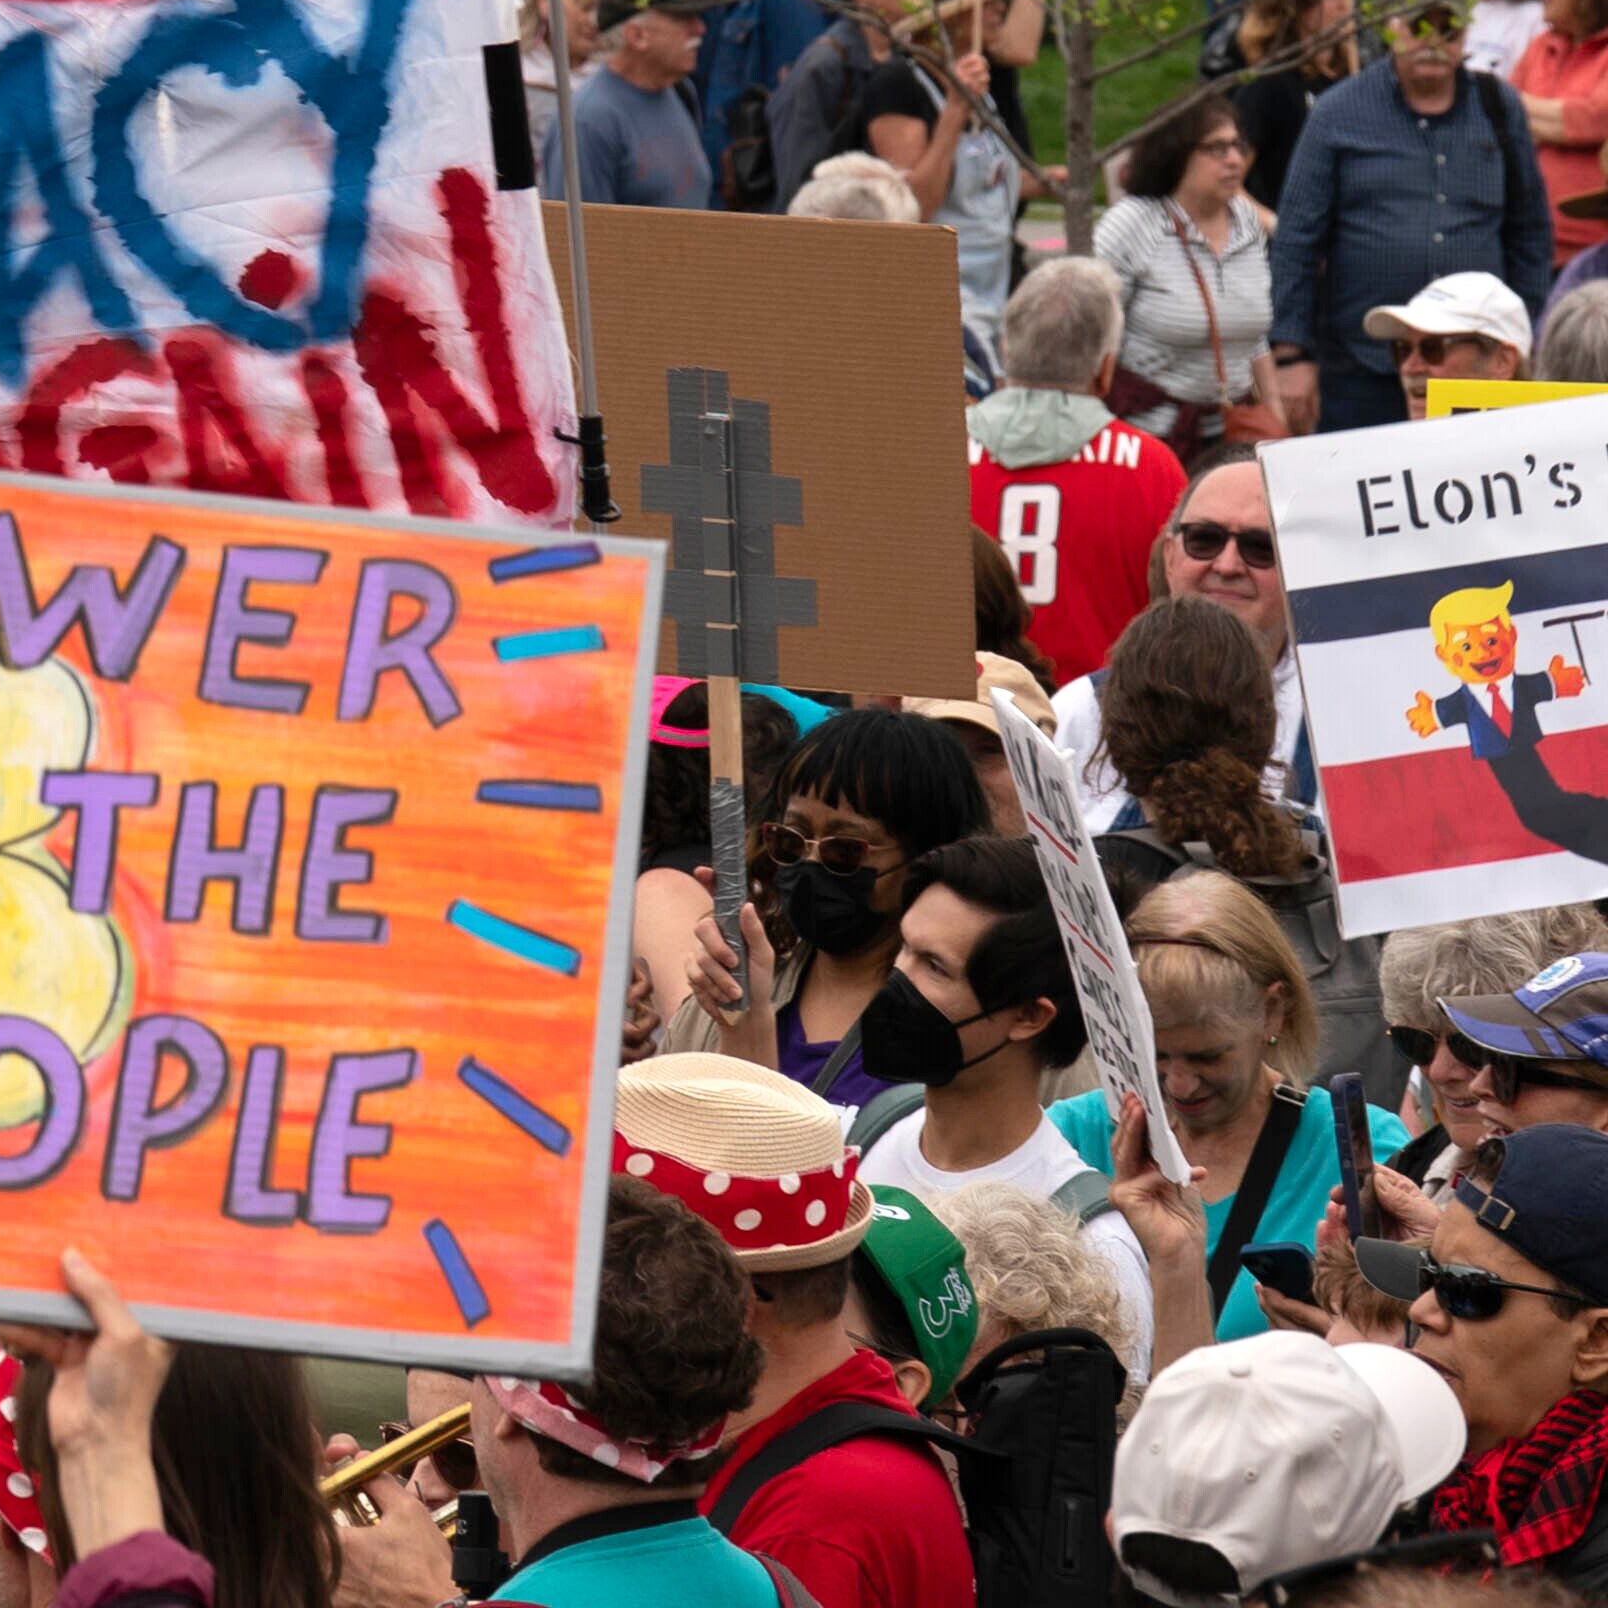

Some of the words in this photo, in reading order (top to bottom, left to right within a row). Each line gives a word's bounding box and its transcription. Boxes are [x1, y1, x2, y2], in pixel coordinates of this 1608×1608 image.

[998, 482, 1062, 606] 8
[1357, 453, 1585, 540] Elon's
[41, 768, 399, 945] THE
